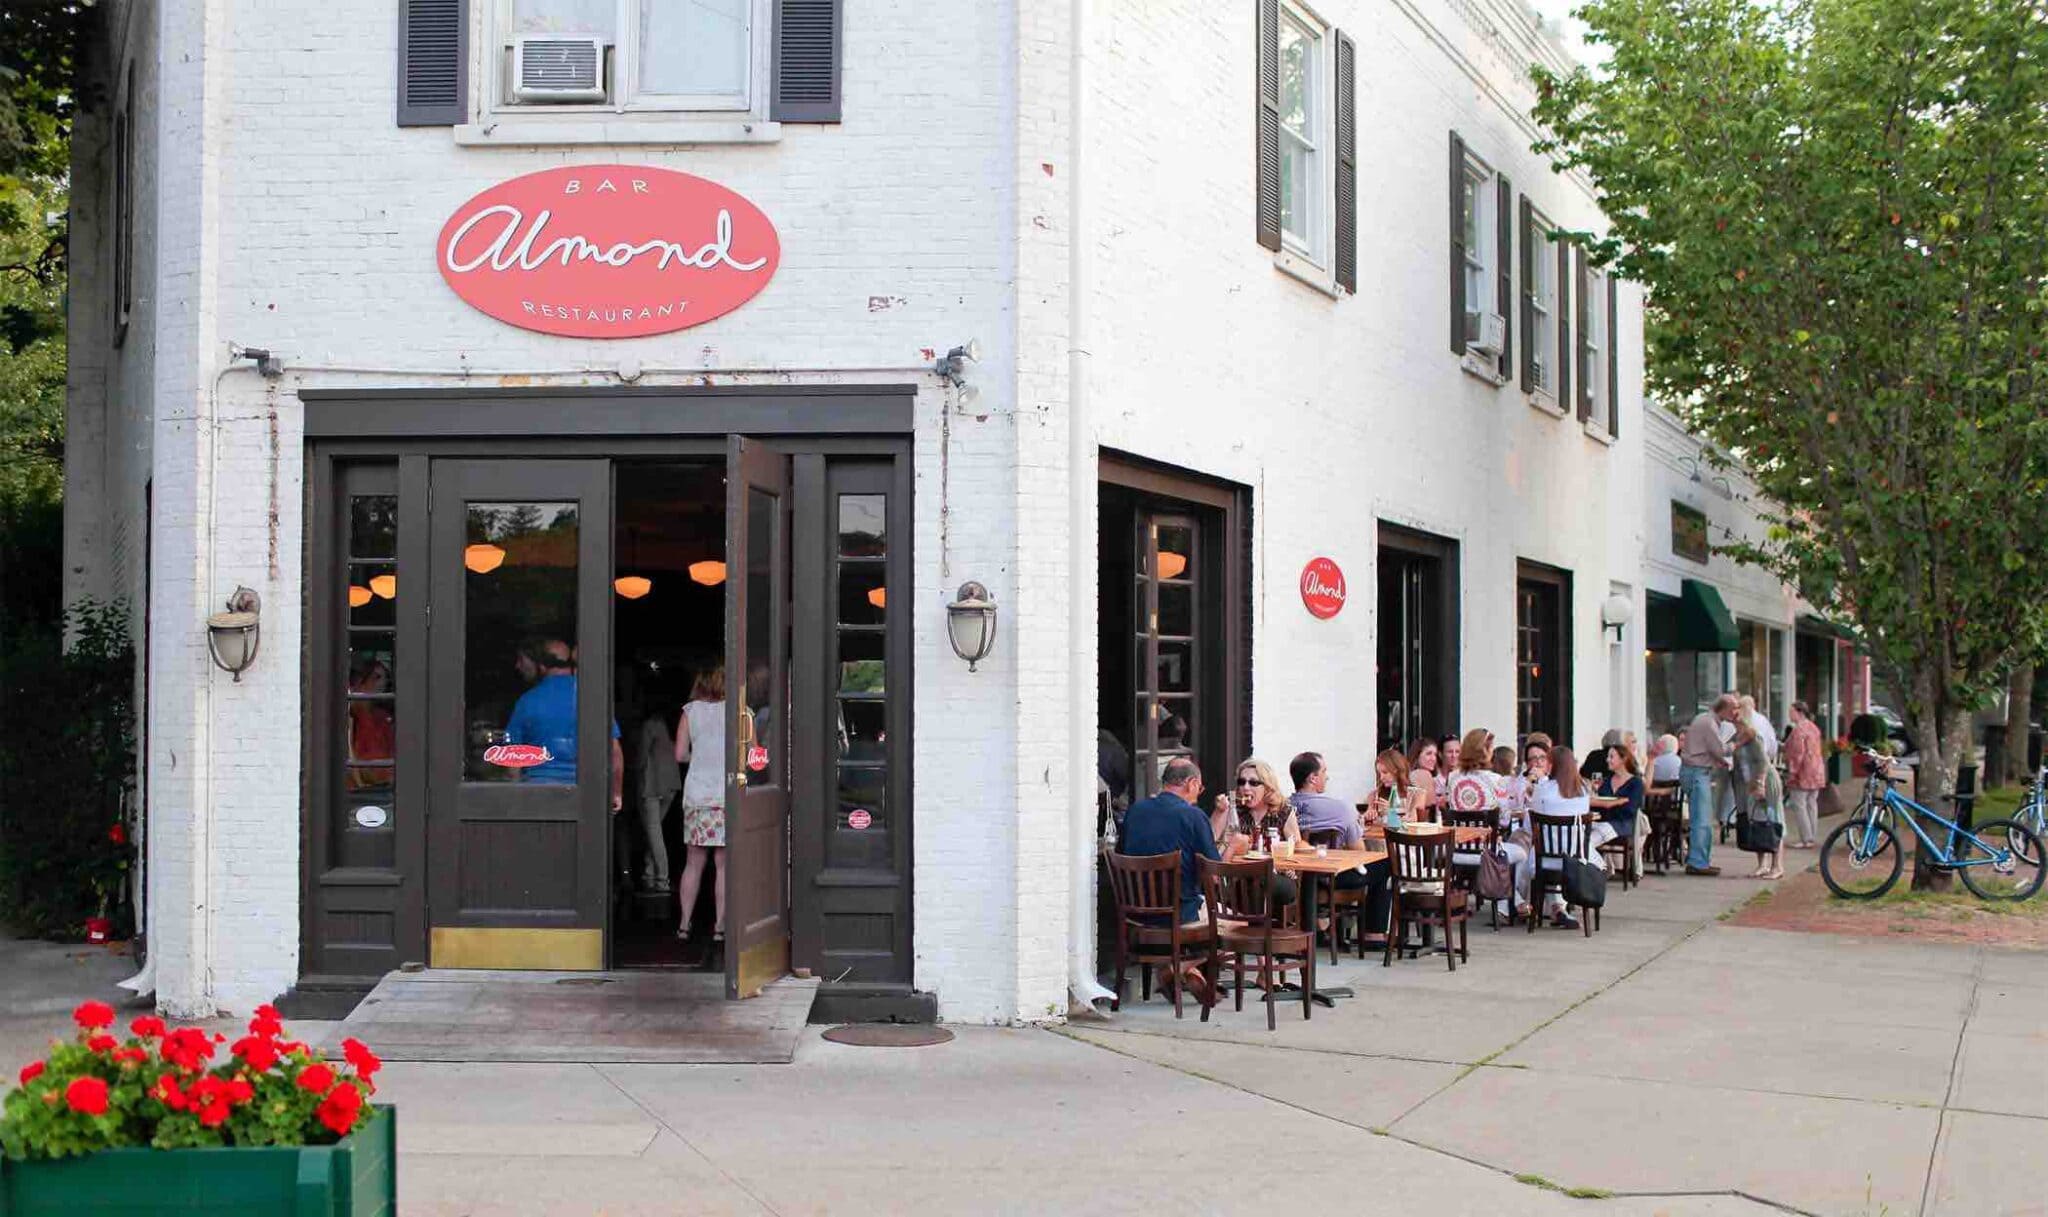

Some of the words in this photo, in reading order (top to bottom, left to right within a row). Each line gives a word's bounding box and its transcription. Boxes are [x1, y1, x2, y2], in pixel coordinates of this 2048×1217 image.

[565, 179, 649, 194] BAR
[446, 204, 767, 273] Almond
[521, 300, 688, 323] RESTAURANT
[484, 745, 554, 761] Almond
